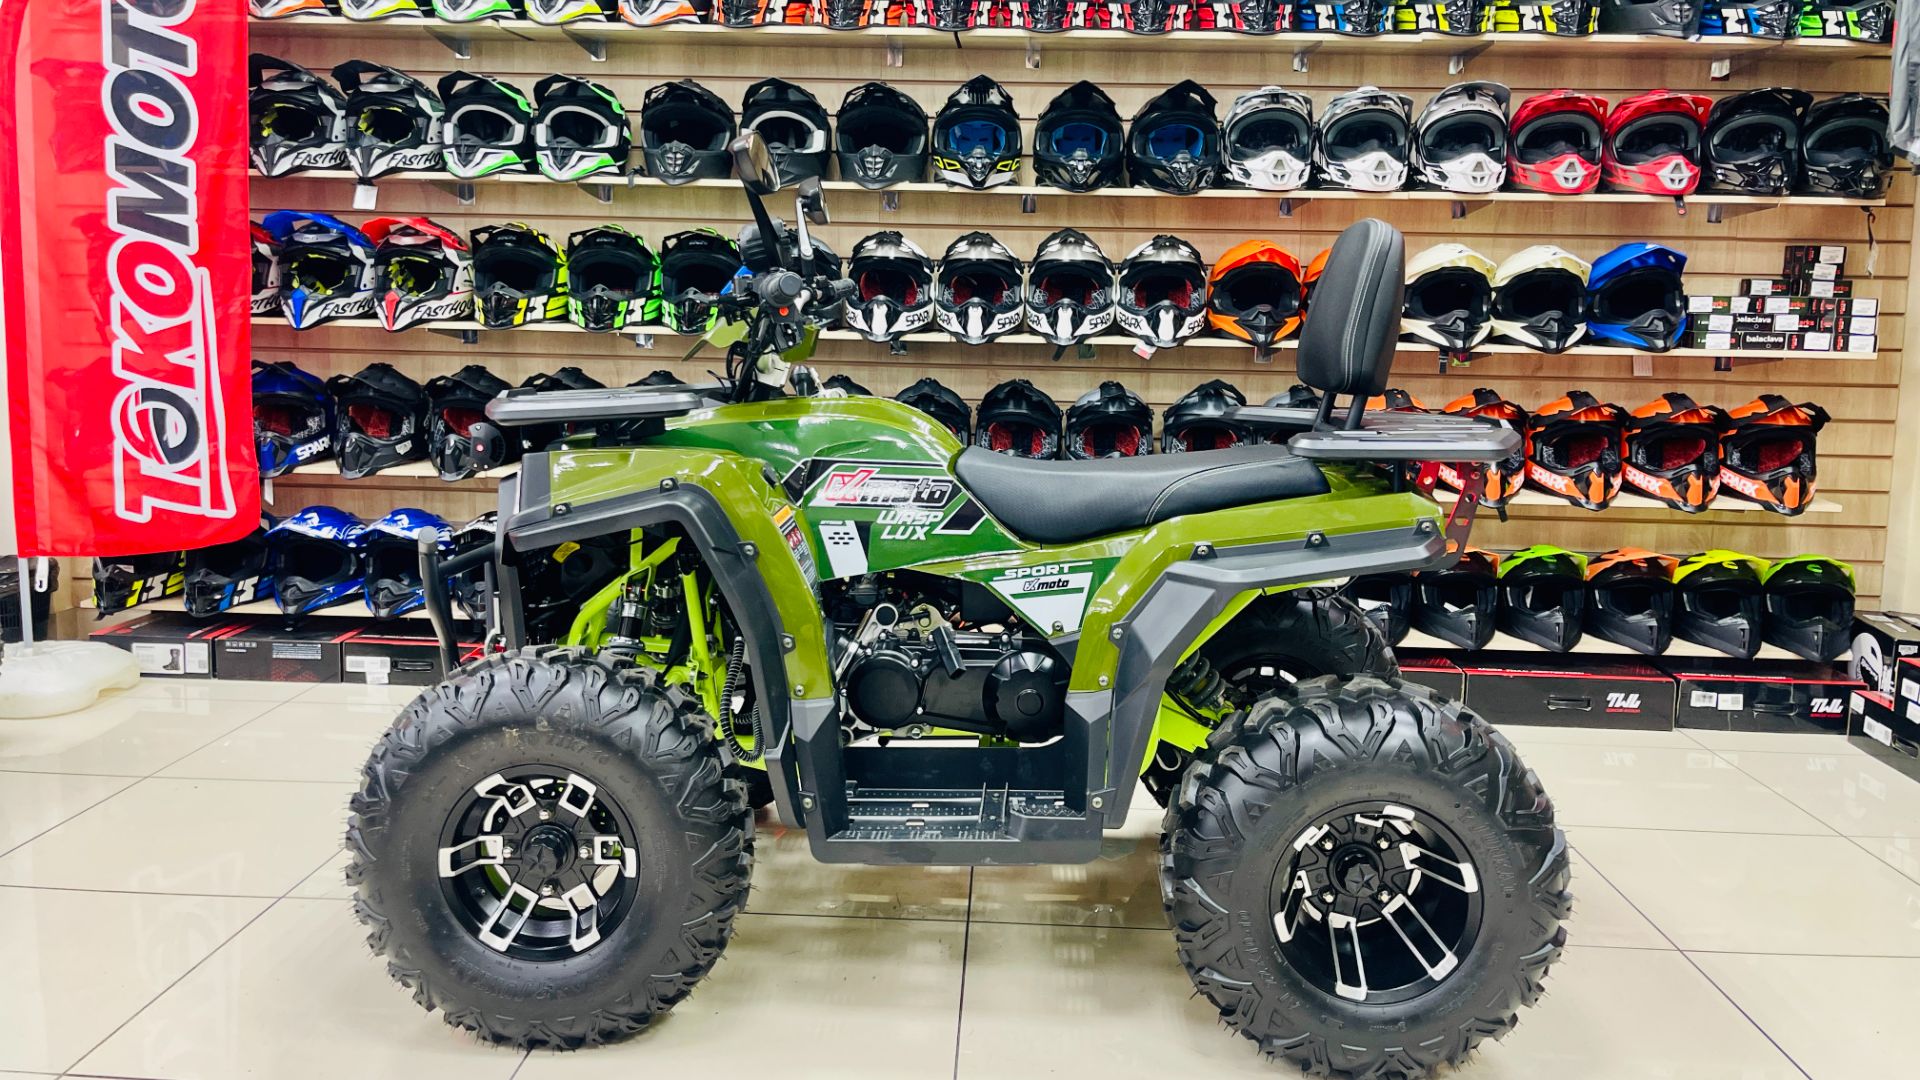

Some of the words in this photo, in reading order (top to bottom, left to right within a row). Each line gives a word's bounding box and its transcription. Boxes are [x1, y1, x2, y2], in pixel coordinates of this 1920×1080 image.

[1746, 335, 1783, 343] balaclava
[876, 510, 944, 525] WASP
[880, 525, 931, 541] LUX
[999, 563, 1081, 579] SPORT
